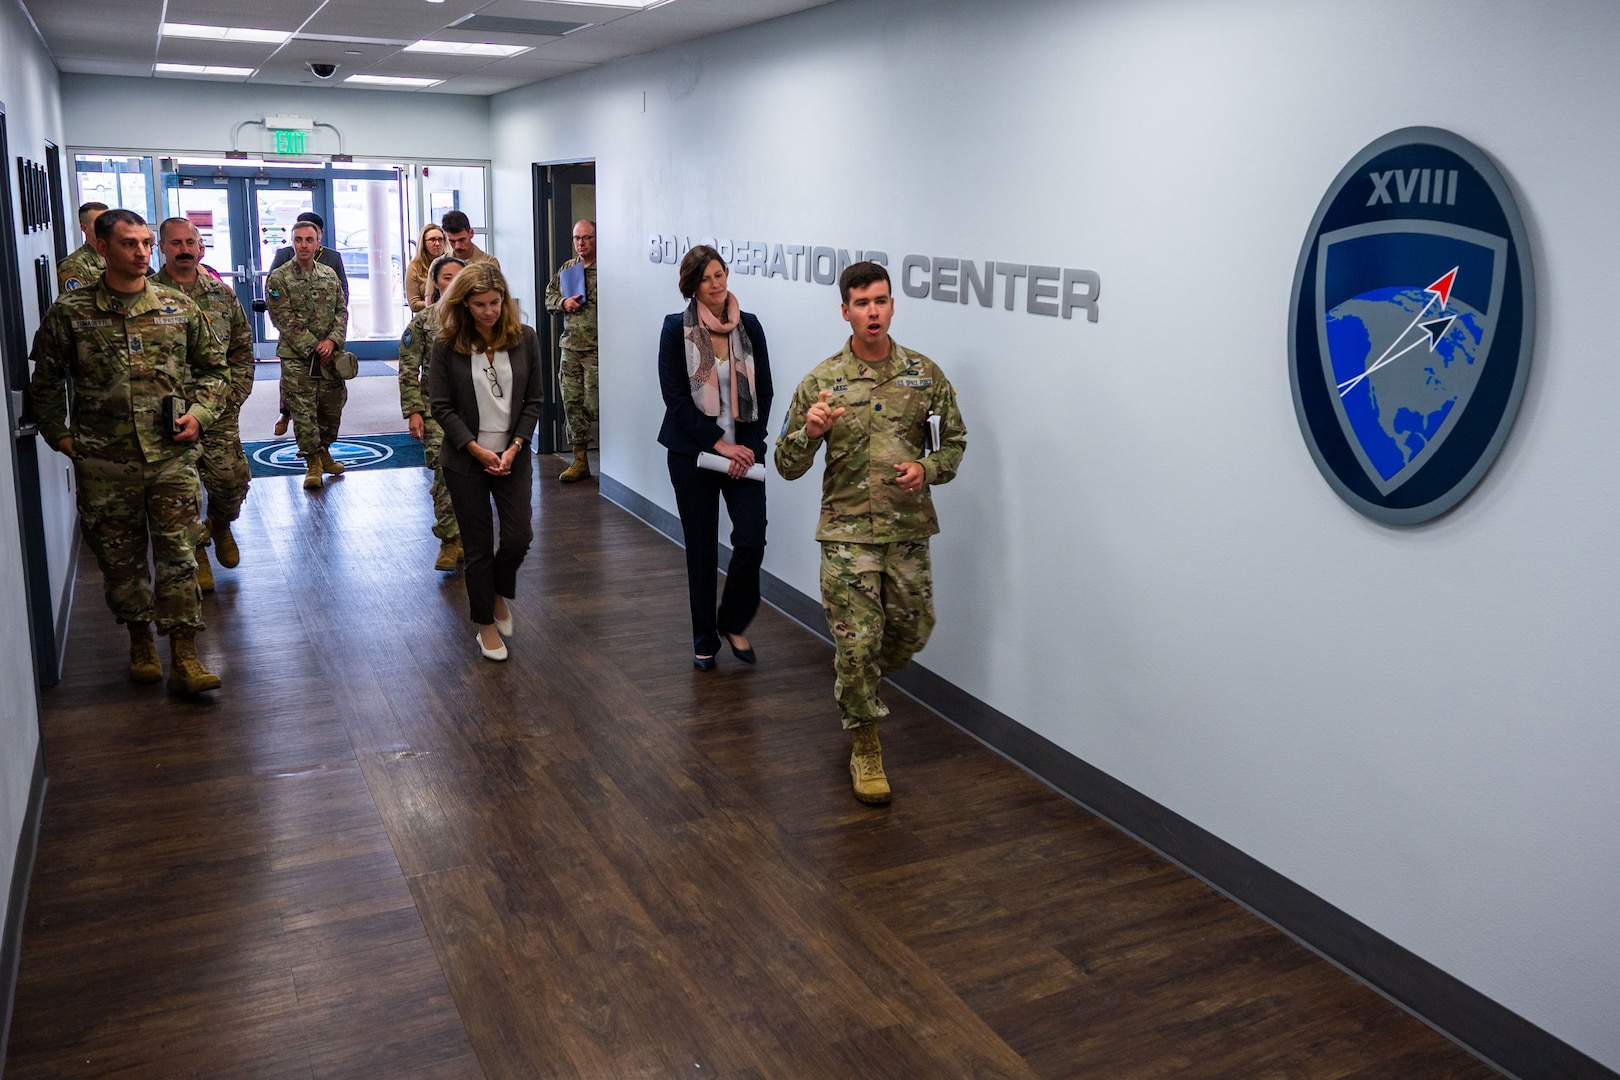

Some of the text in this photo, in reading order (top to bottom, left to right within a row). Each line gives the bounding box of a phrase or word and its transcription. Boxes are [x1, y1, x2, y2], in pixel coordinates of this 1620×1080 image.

[275, 130, 306, 154] EXIT
[1366, 168, 1458, 206] XVIII
[700, 237, 888, 285] PERATION
[902, 254, 1100, 322] CENTER
